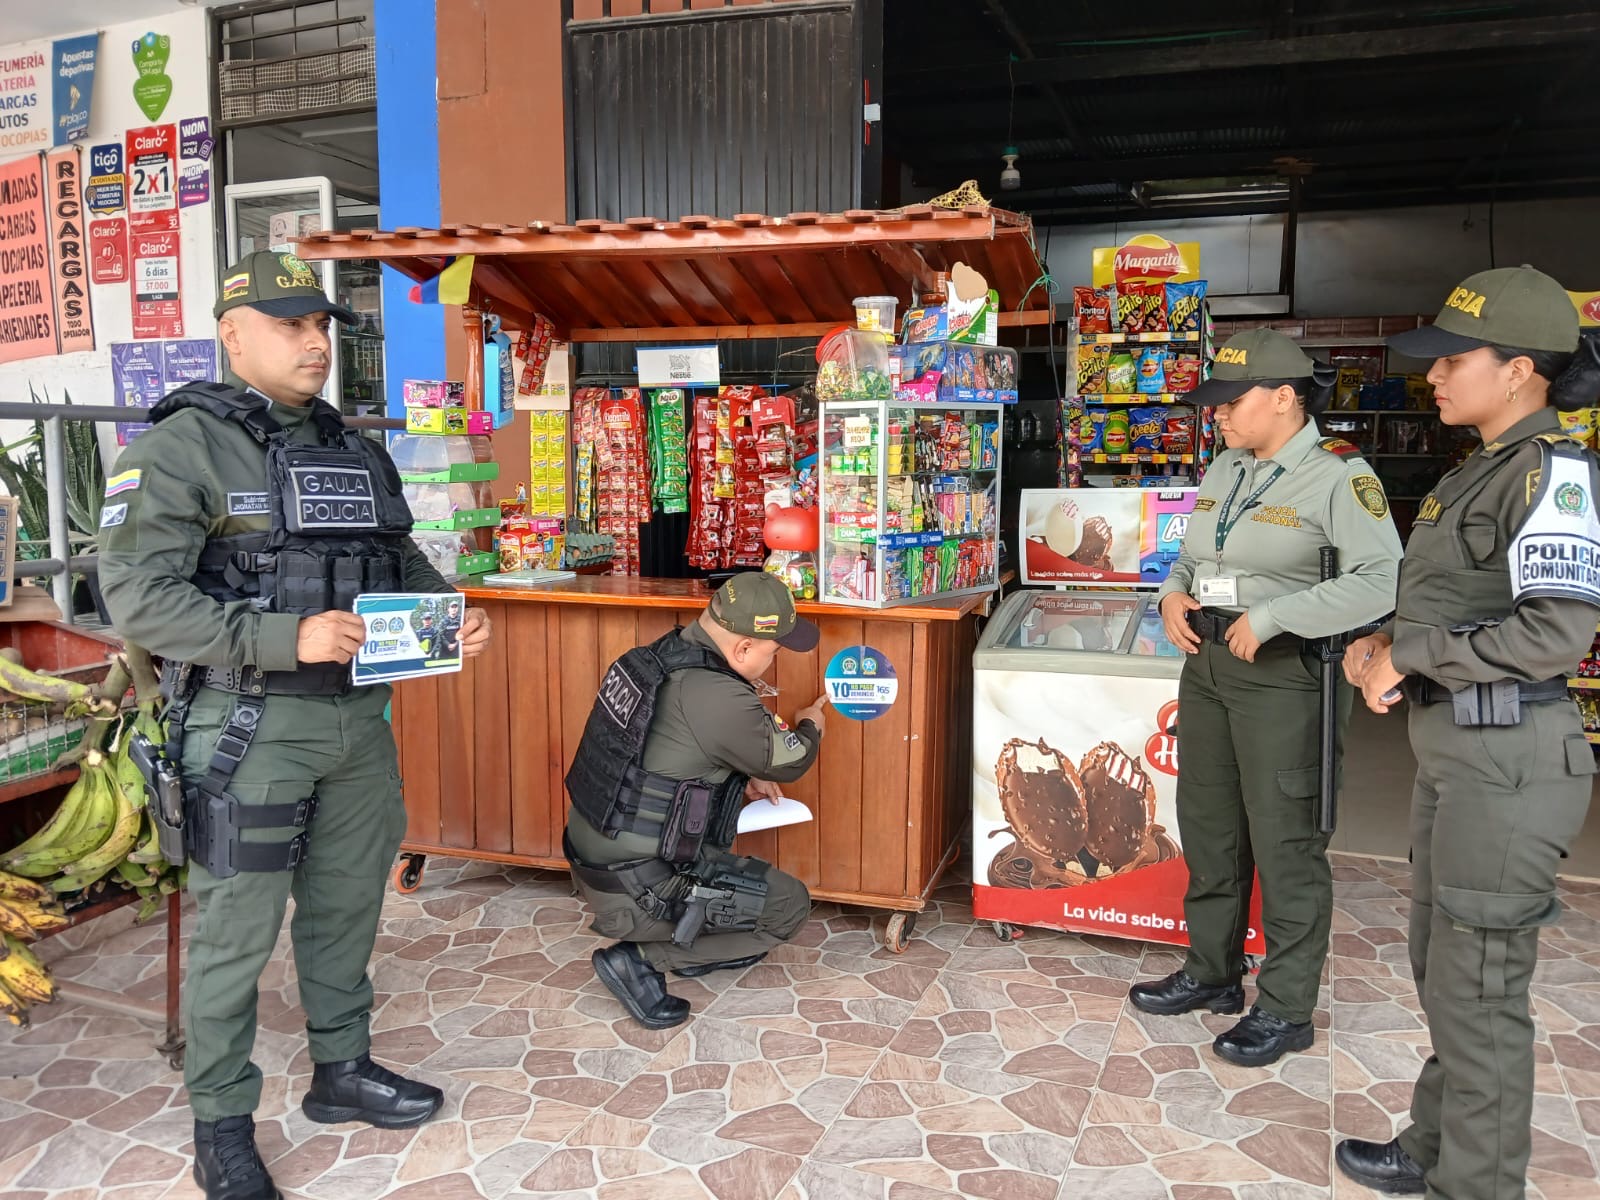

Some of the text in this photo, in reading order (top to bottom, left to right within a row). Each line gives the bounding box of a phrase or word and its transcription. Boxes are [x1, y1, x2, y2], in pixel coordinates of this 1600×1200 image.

[62, 49, 94, 64] Apuestas
[59, 62, 94, 78] deportivas
[182, 120, 206, 137] WOM
[135, 137, 163, 150] Claro
[183, 165, 204, 178] WOM
[93, 227, 117, 237] Claro
[56, 161, 84, 318] RECARGAS
[140, 243, 167, 255] Claro
[1114, 252, 1180, 275] Margarita
[145, 267, 151, 277] 6
[145, 281, 169, 291] $7.000
[1079, 306, 1105, 315] Doritos
[66, 320, 82, 329] TODO
[63, 327, 91, 339] OPERADOR
[660, 394, 678, 402] MILO
[303, 475, 366, 493] GAULA
[302, 503, 374, 520] POLICIA
[363, 640, 377, 654] YO
[603, 669, 634, 720] POLICIA
[832, 682, 850, 697] YO
[876, 685, 890, 694] 165
[1063, 902, 1085, 919] La
[1088, 903, 1127, 925] vida
[1130, 909, 1175, 930] sabe
